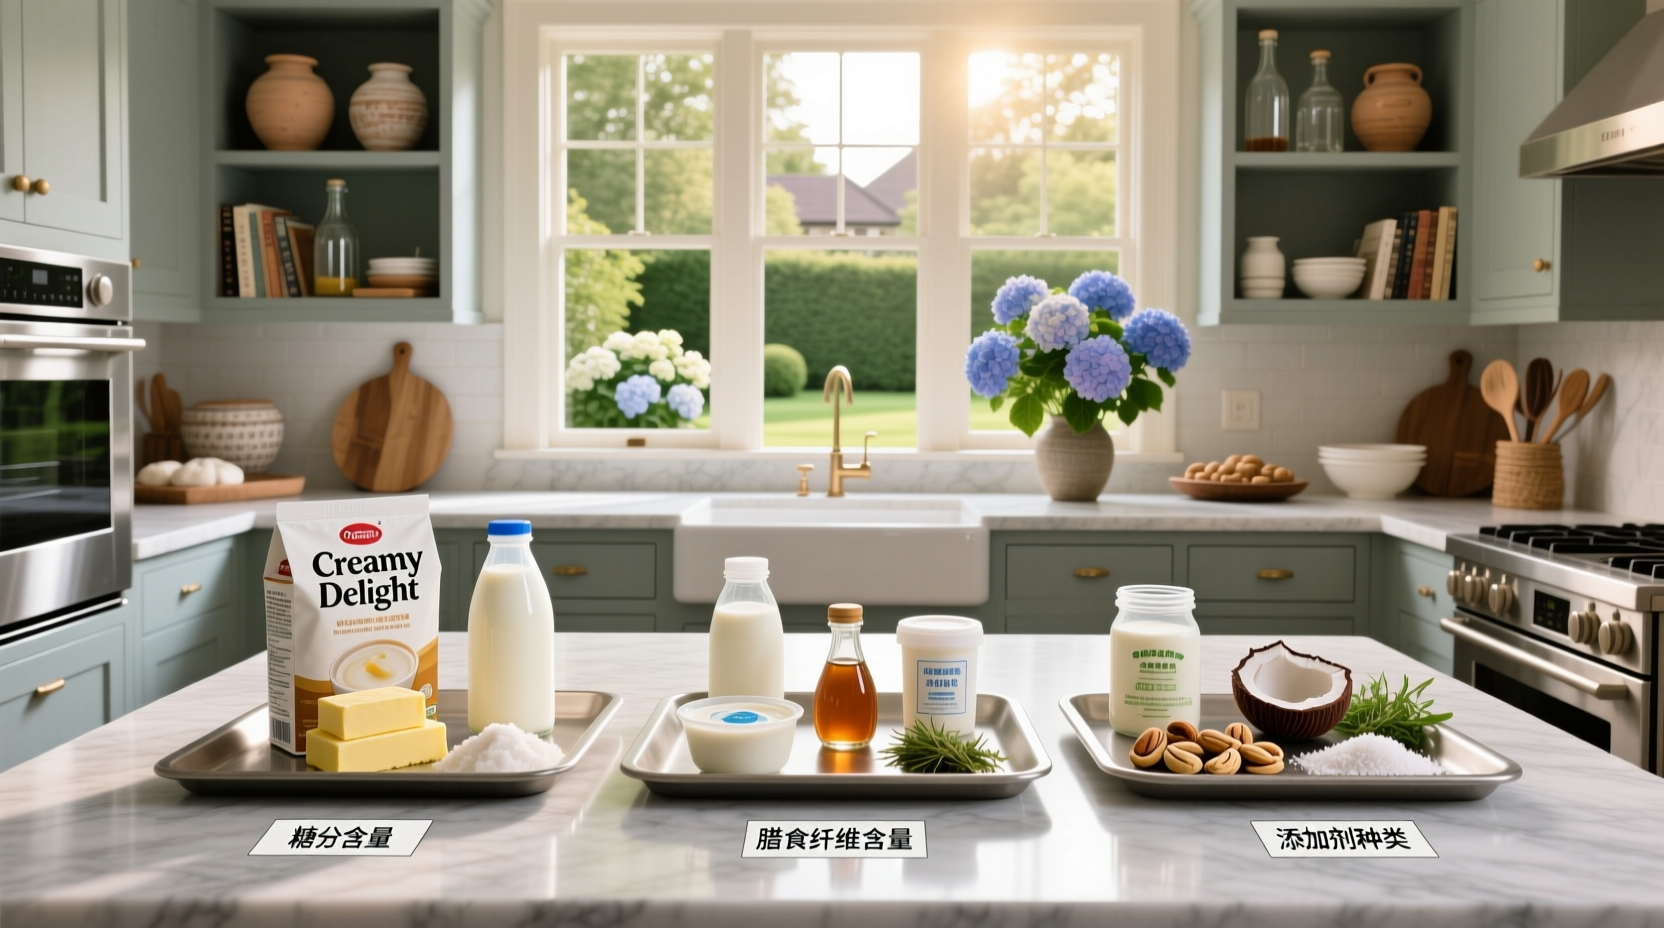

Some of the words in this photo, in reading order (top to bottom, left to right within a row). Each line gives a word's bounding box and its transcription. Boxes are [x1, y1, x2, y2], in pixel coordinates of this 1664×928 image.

[313, 551, 423, 578] Creamy
[320, 576, 420, 612] Delight
[288, 825, 393, 849] 糖分含量
[1277, 826, 1412, 851] 添加剂种类
